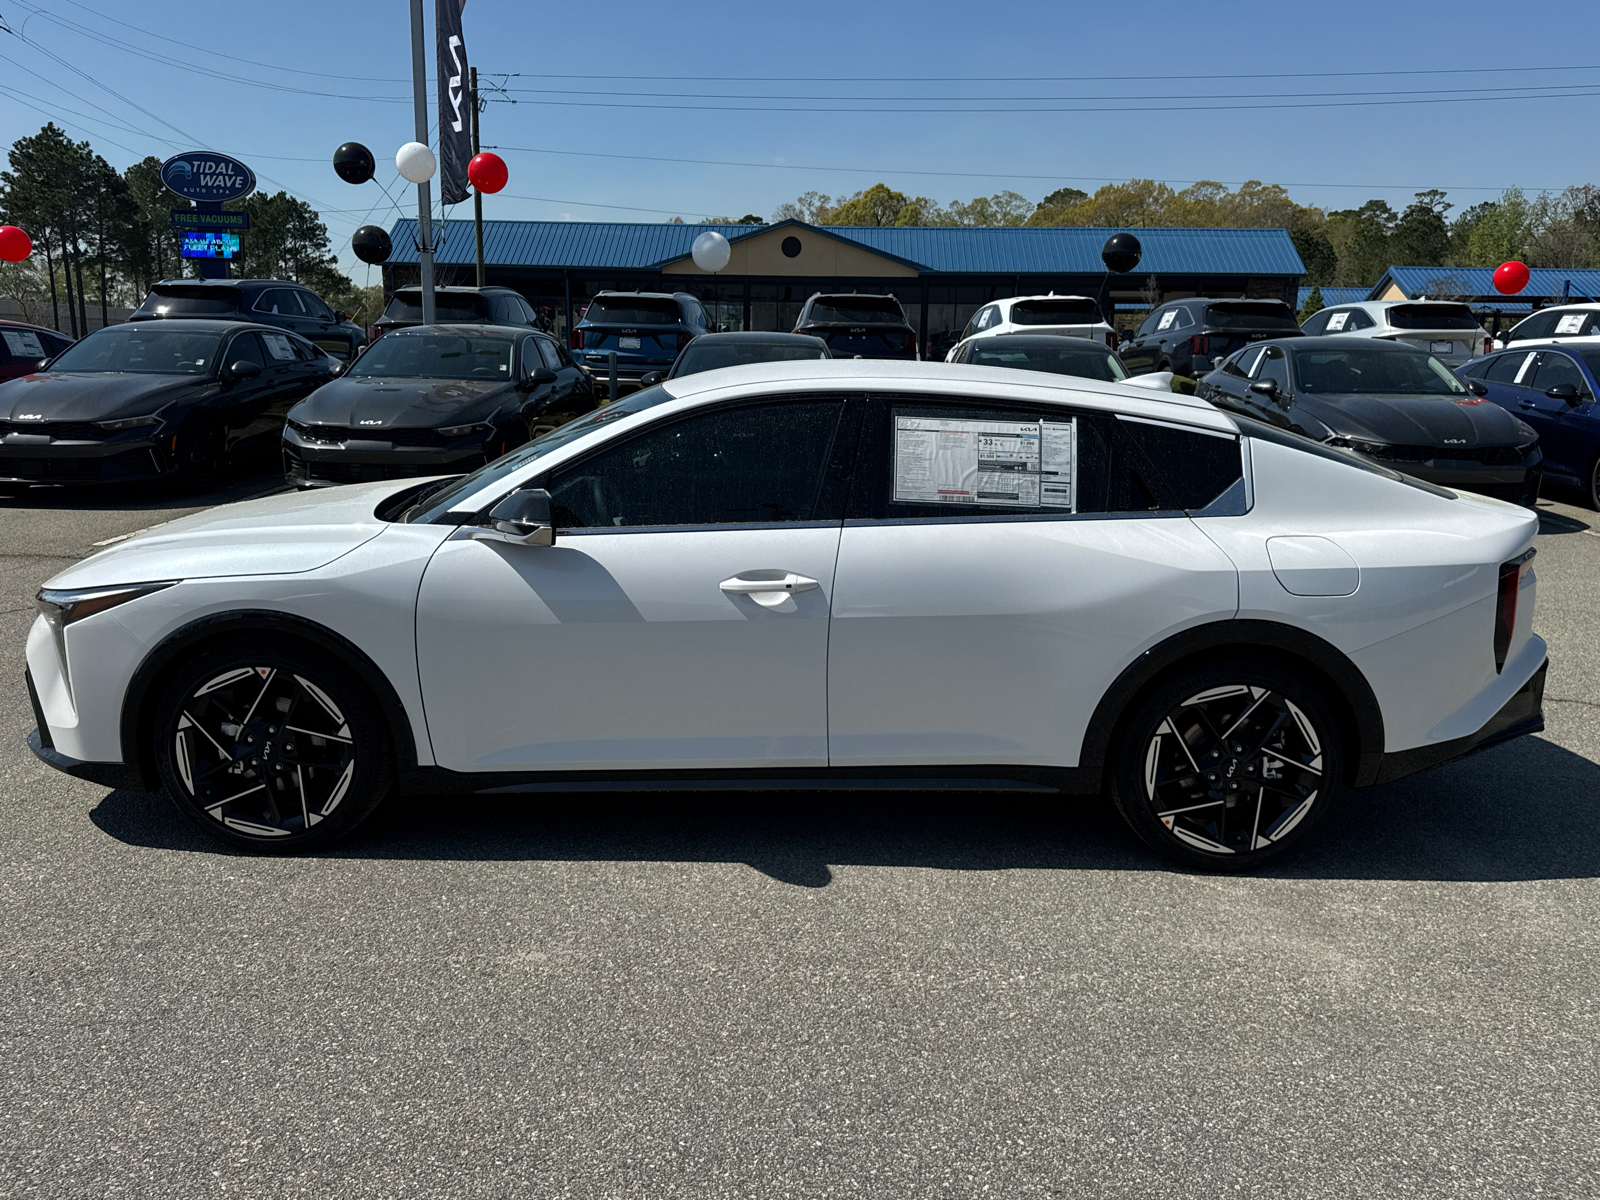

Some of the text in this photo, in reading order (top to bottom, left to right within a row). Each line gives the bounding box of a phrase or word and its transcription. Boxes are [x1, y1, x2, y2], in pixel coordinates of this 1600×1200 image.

[192, 161, 235, 175] TIDAL
[200, 174, 244, 188] WAVE
[174, 214, 243, 224] FREE VACUUMS
[983, 438, 993, 446] 33
